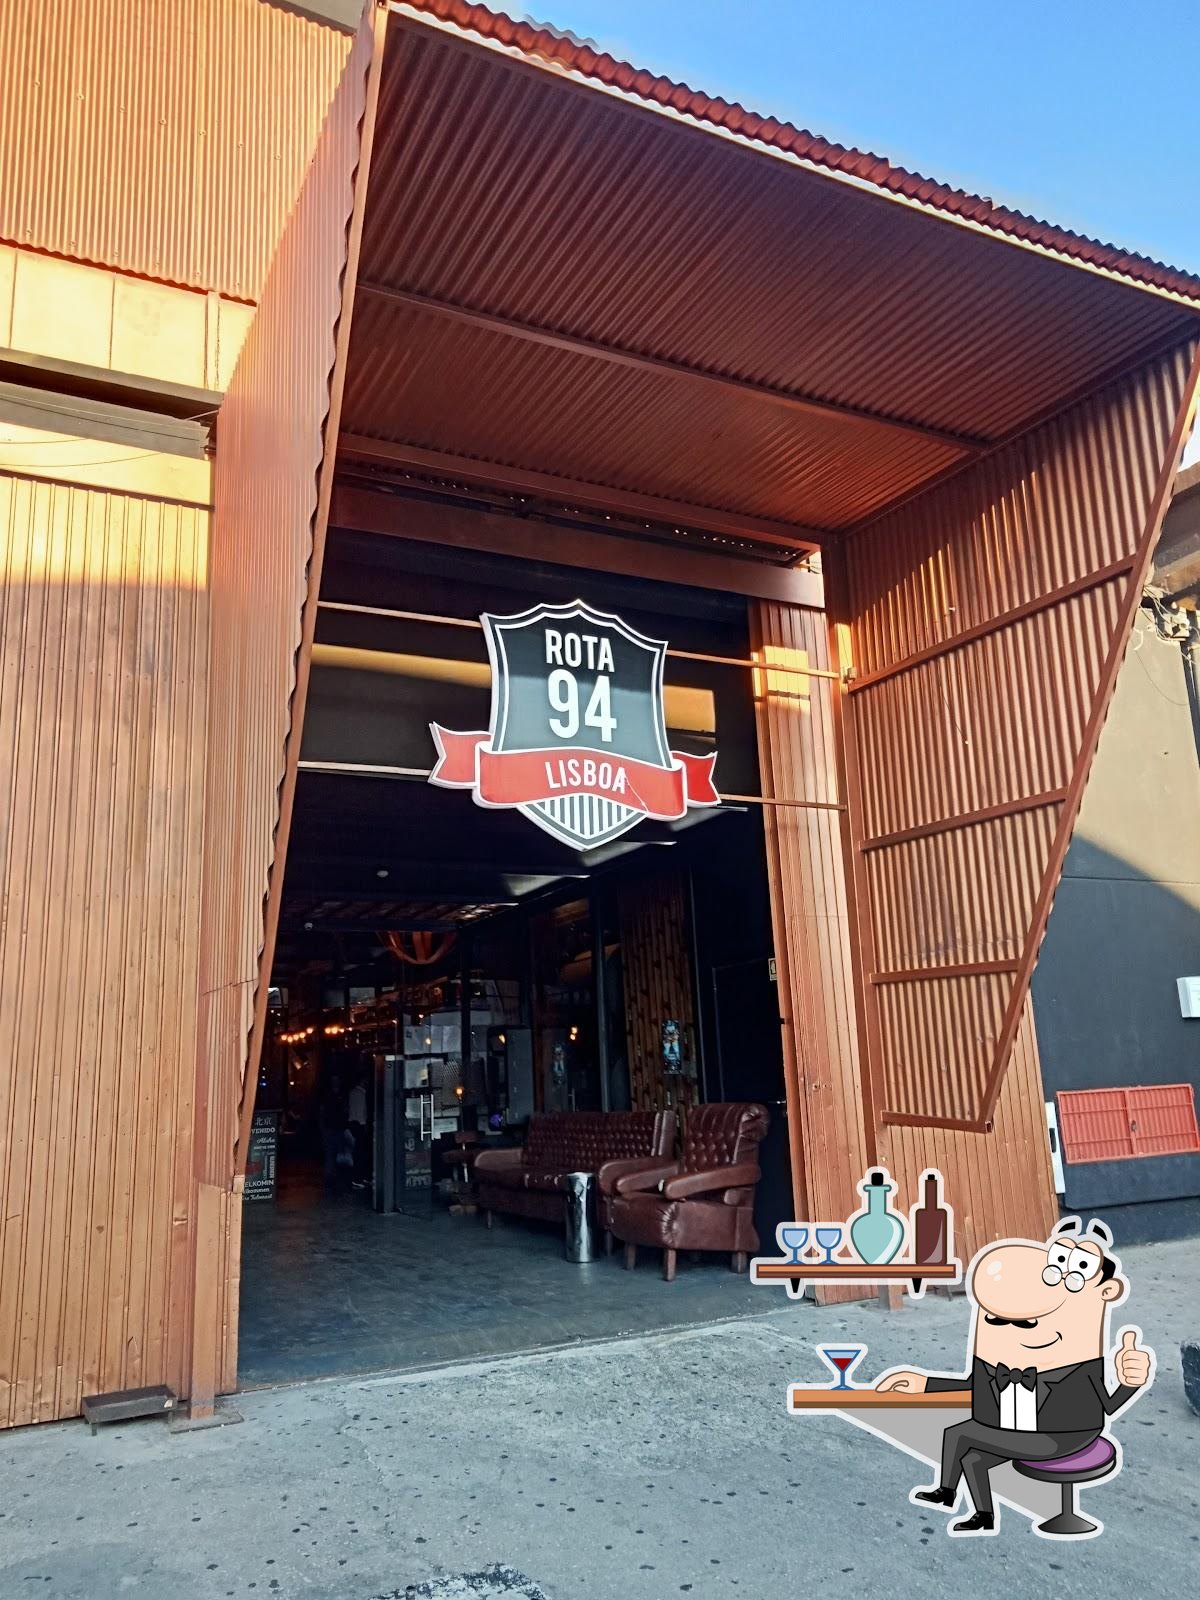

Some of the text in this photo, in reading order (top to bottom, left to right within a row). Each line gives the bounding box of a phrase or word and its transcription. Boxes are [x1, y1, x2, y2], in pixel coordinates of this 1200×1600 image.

[545, 629, 615, 673] ROTA
[548, 668, 617, 742] 94
[545, 758, 627, 794] LISBOA
